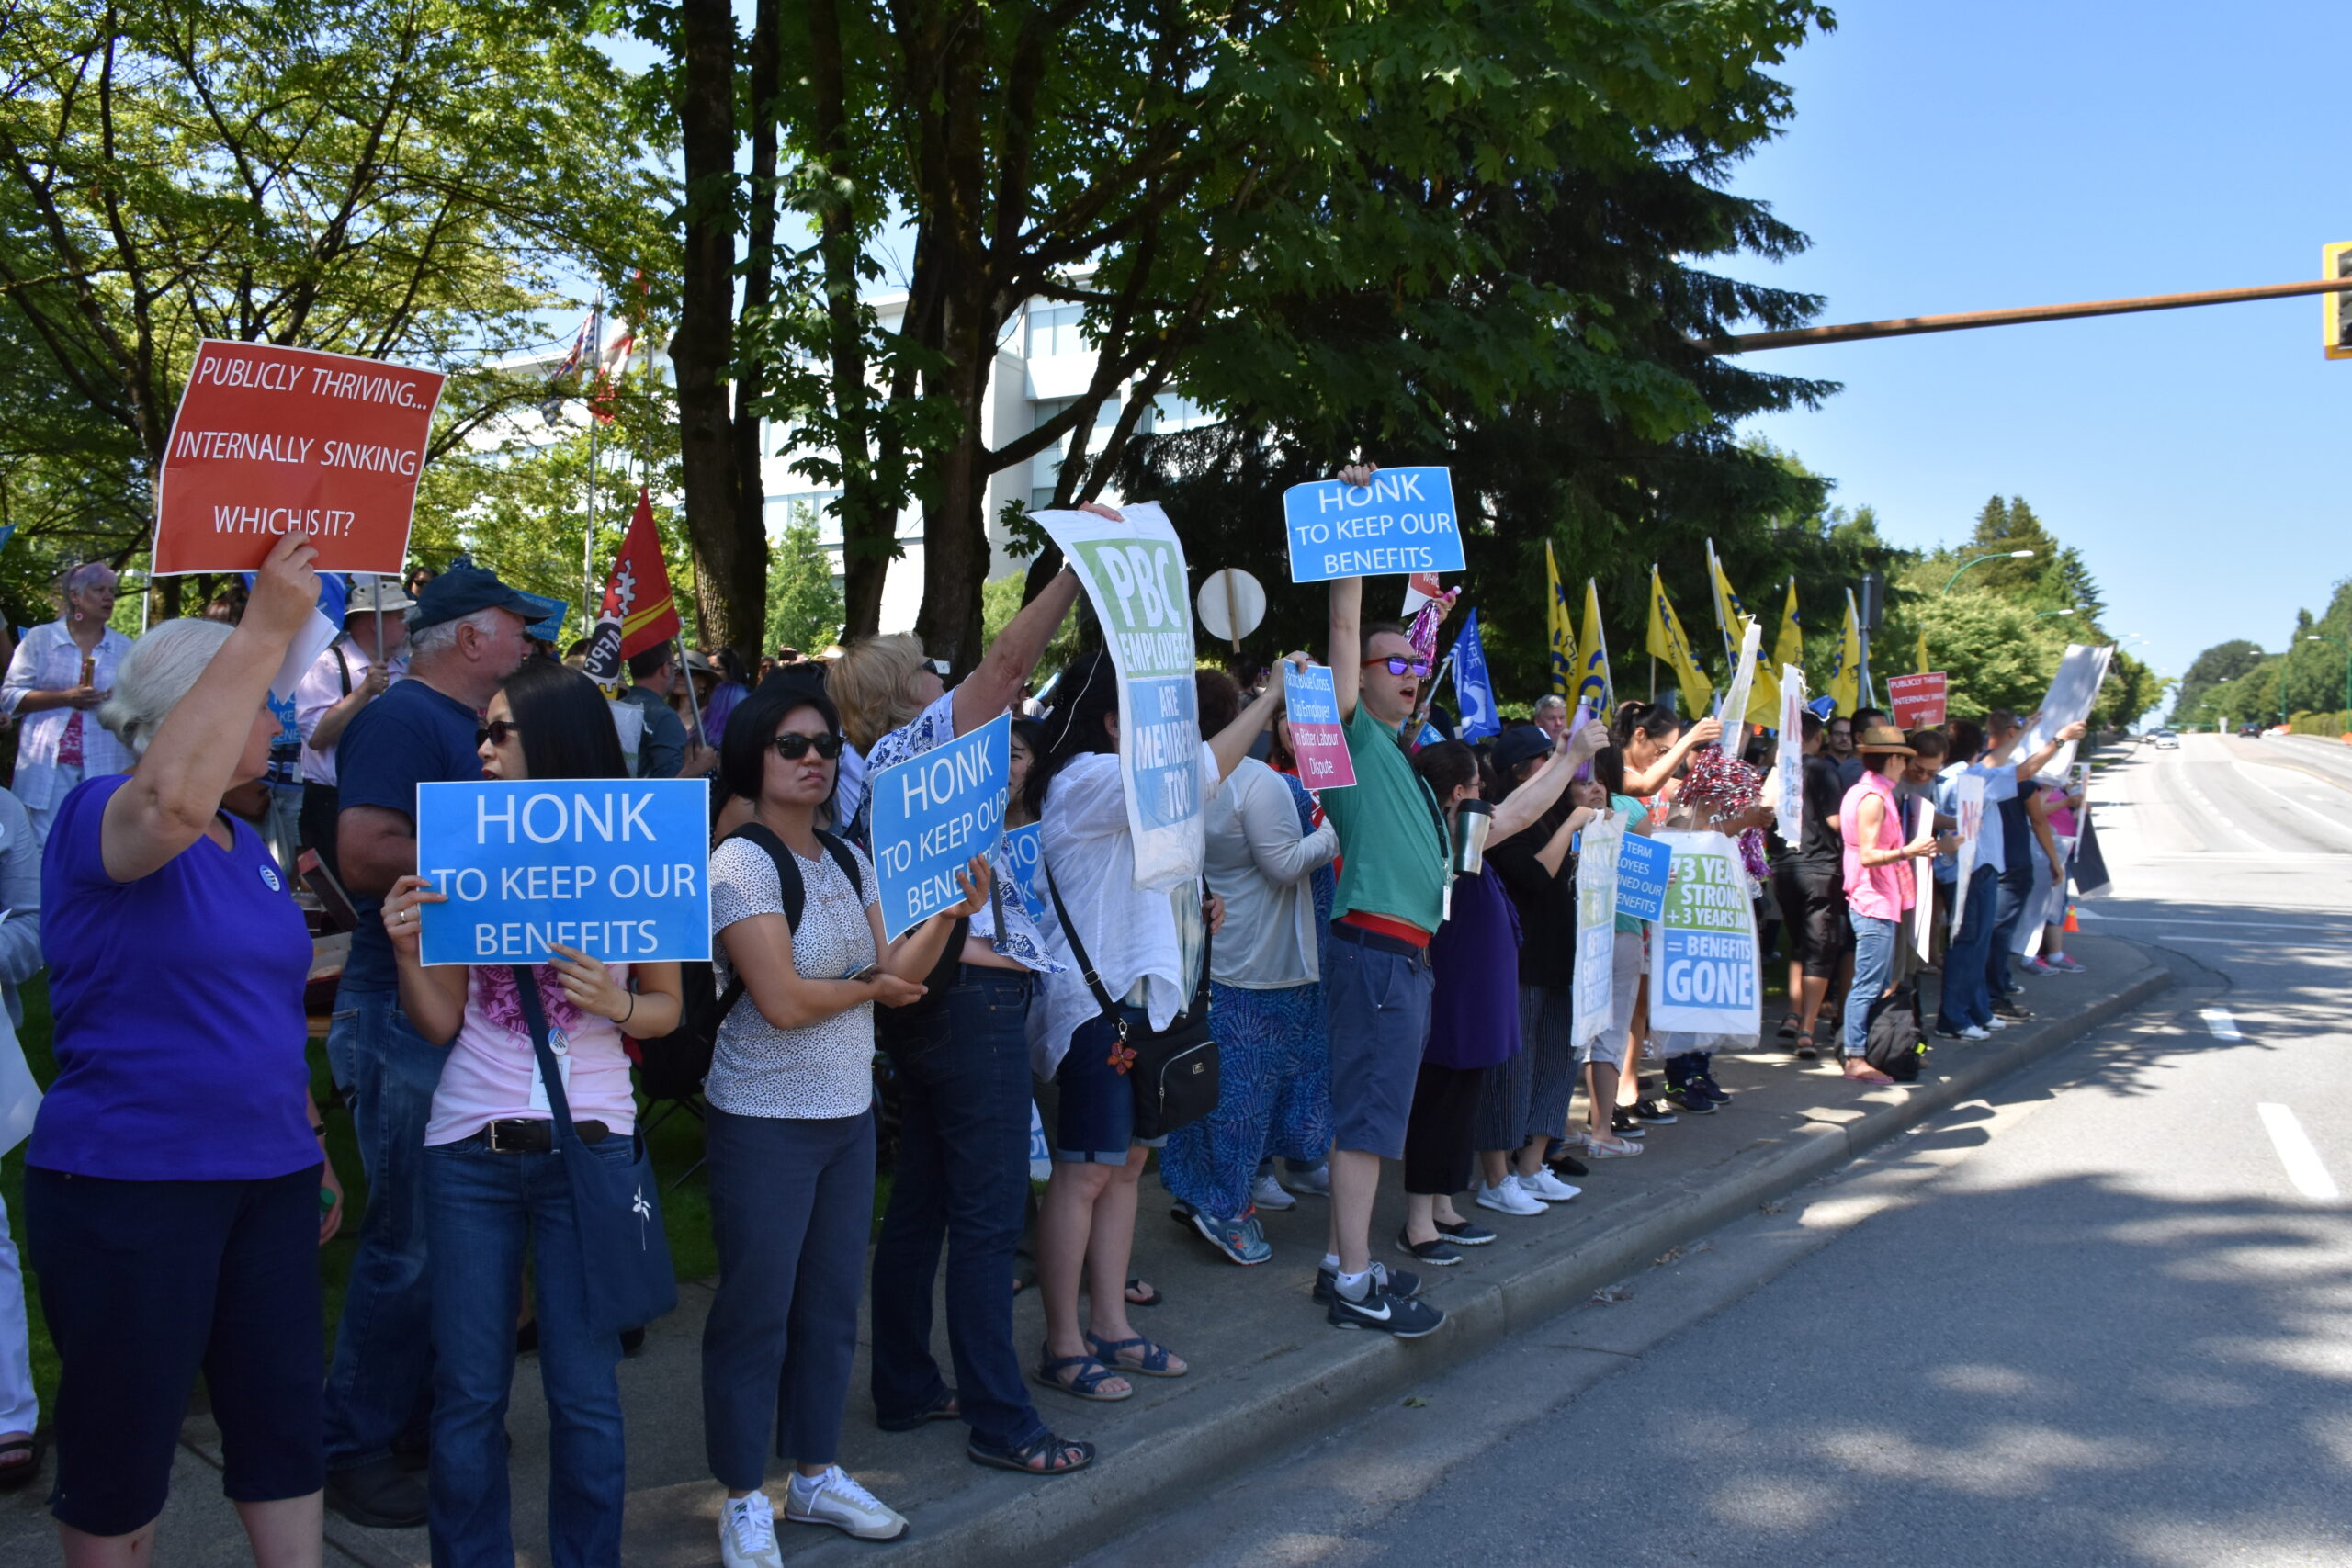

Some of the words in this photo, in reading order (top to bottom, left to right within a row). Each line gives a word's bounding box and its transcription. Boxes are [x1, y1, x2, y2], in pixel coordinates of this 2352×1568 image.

[198, 356, 305, 391] PUBLICLY
[312, 367, 427, 411] THRIVING...
[175, 431, 314, 464] INTERNALLY
[320, 440, 417, 476] SINKING
[1318, 474, 1426, 513] HONK
[214, 505, 302, 536] WHICH
[305, 509, 320, 536] IS
[324, 510, 355, 537] IT?
[1295, 524, 1329, 546] TO
[1336, 515, 1394, 540] KEEP
[1400, 513, 1453, 535] OUR
[1324, 547, 1433, 574] BENEFITS
[1095, 544, 1182, 627] PBC
[1118, 632, 1191, 672] EMPLOYEES
[1285, 668, 1298, 689] Pacific
[1298, 672, 1313, 689] Blue
[1159, 685, 1180, 717] ARE
[1291, 698, 1302, 722] Top
[1301, 699, 1330, 723] Employer
[1294, 728, 1300, 745] In
[1300, 728, 1316, 746] Bitter
[1316, 728, 1339, 746] Labour
[902, 735, 994, 818] HONK
[1308, 757, 1334, 779] Dispute
[1164, 767, 1191, 818] TOO
[477, 793, 657, 844] HONK
[880, 840, 912, 879] TO
[920, 812, 973, 862] KEEP
[978, 786, 1007, 832] OUR
[1617, 857, 1650, 875] OYEES
[1626, 841, 1652, 859] TERM
[431, 868, 488, 902] TO
[501, 866, 597, 900] KEEP
[609, 863, 696, 898] OUR
[1670, 857, 1696, 883] 73
[1617, 892, 1657, 914] ENEFITS
[1641, 881, 1663, 897] OUR
[1680, 883, 1742, 909] STRONG
[1682, 907, 1692, 925] 3
[1695, 908, 1734, 928] YEARS
[475, 919, 659, 955] BENEFITS
[1687, 935, 1751, 961] BENEFITS
[1666, 959, 1752, 1007] GONE
